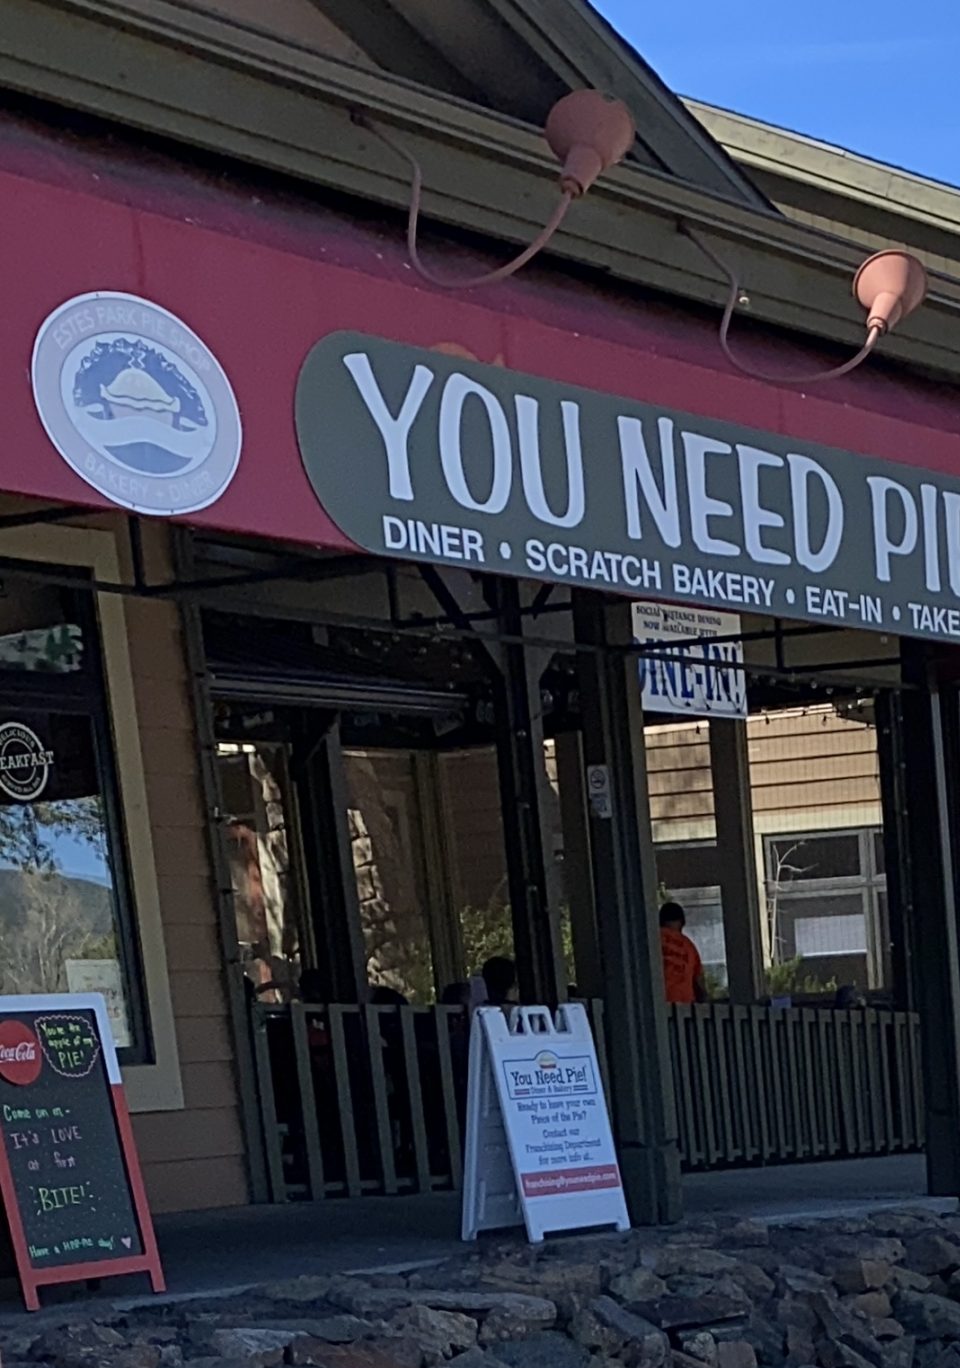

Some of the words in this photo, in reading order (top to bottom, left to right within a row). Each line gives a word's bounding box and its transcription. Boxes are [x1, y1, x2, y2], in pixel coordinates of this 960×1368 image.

[53, 309, 95, 349] ESTES
[97, 306, 139, 327] PARK
[142, 309, 169, 335] PIE
[170, 327, 211, 370] SHOP
[343, 352, 585, 528] YOU
[617, 415, 843, 573] NEED
[83, 452, 148, 501] BAKERY
[168, 471, 215, 502] DINER
[382, 515, 485, 562] DINER
[526, 539, 661, 590] SCRATCH
[672, 564, 775, 607] BAKERY
[806, 586, 882, 623] EAT-IN
[636, 605, 660, 617] SOCIAL
[643, 621, 660, 630] NOW
[58, 1050, 84, 1068] PIE!
[510, 1071, 532, 1086] You
[534, 1068, 563, 1085] Need
[565, 1064, 588, 1083] Pie!
[3, 1104, 31, 1122] Come
[517, 1101, 538, 1113] Ready
[540, 1100, 547, 1109] to
[548, 1099, 564, 1109] have
[565, 1098, 581, 1110] your
[551, 1112, 559, 1122] of
[560, 1111, 571, 1121] the
[10, 1130, 40, 1150] It's
[51, 1125, 83, 1144] LOVE
[542, 1128, 567, 1139] Contact
[38, 1185, 86, 1212] BITE!
[29, 1244, 50, 1258] Have
